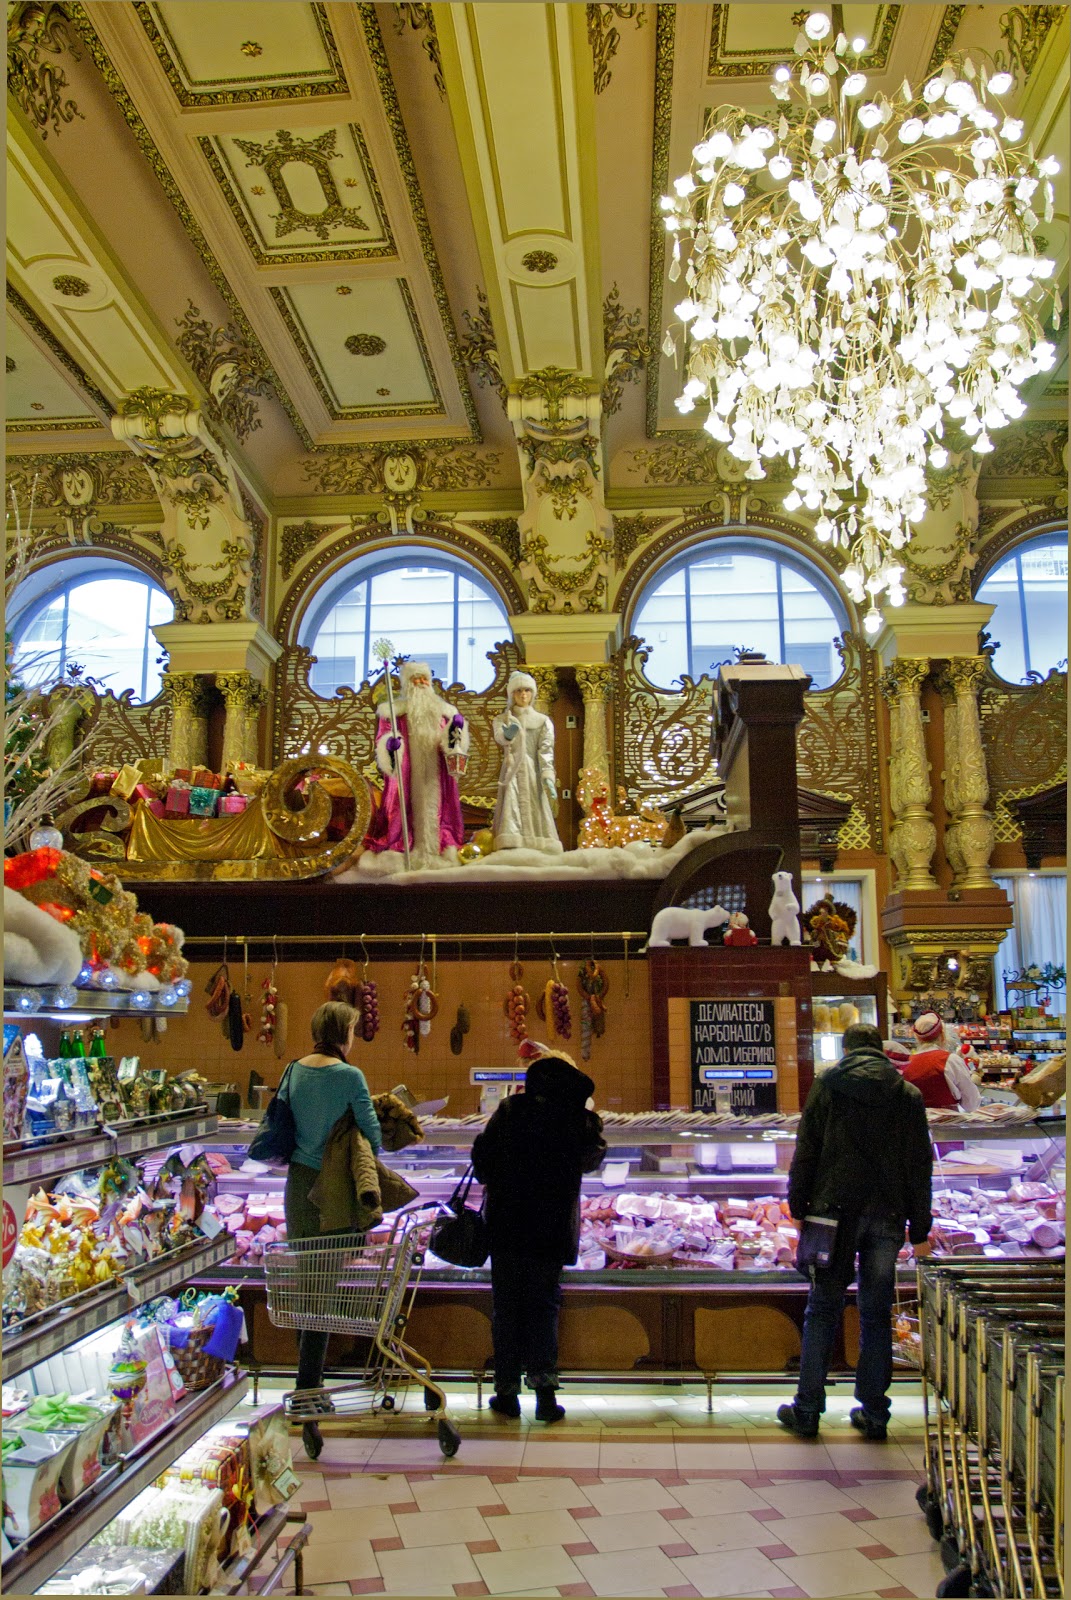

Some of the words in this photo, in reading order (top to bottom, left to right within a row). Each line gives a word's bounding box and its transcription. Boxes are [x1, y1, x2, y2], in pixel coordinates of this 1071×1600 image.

[697, 1003, 764, 1022] ДЕЛИКАТЕСЫ
[695, 1046, 730, 1064] ЛОМО
[733, 1046, 775, 1064] ИБЕРИКО
